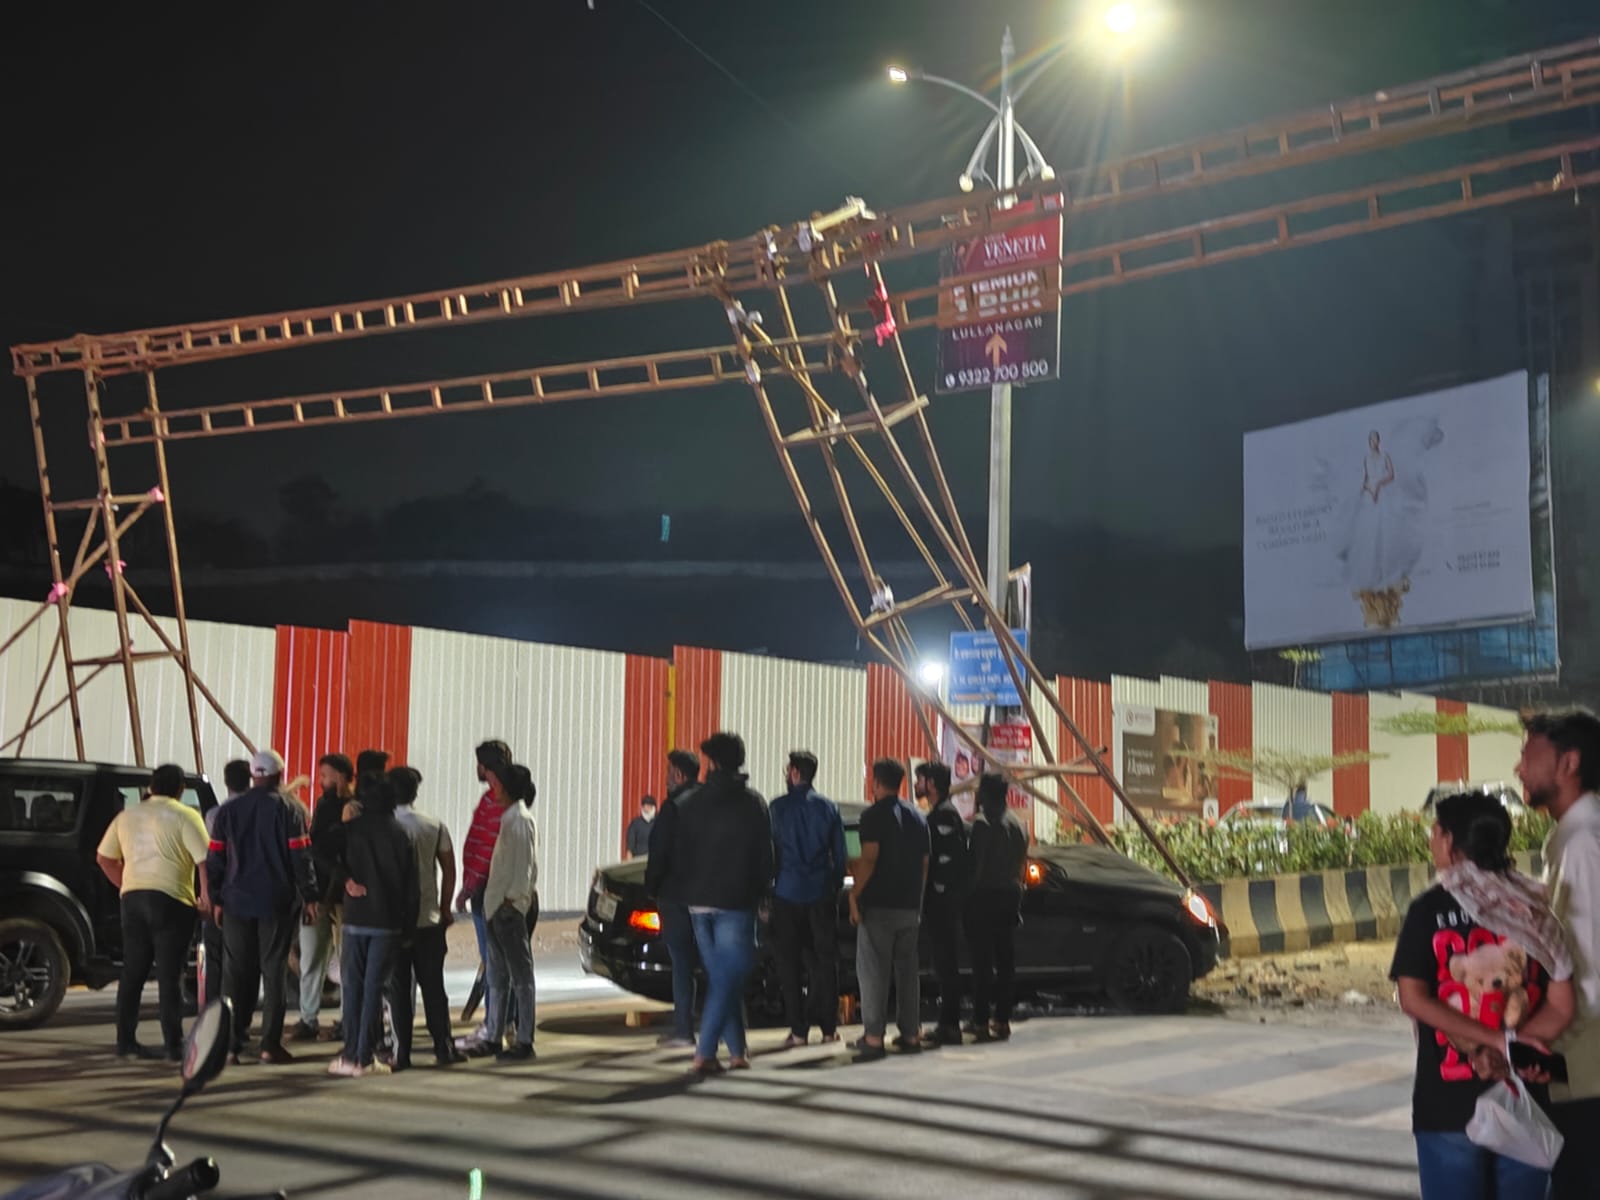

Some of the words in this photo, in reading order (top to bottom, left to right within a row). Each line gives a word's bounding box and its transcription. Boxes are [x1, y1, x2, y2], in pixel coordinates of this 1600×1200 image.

[983, 233, 1047, 260] VENETIA
[952, 315, 1043, 341] LULLANAGAR
[958, 367, 991, 386] 9322
[993, 362, 1019, 382] 700
